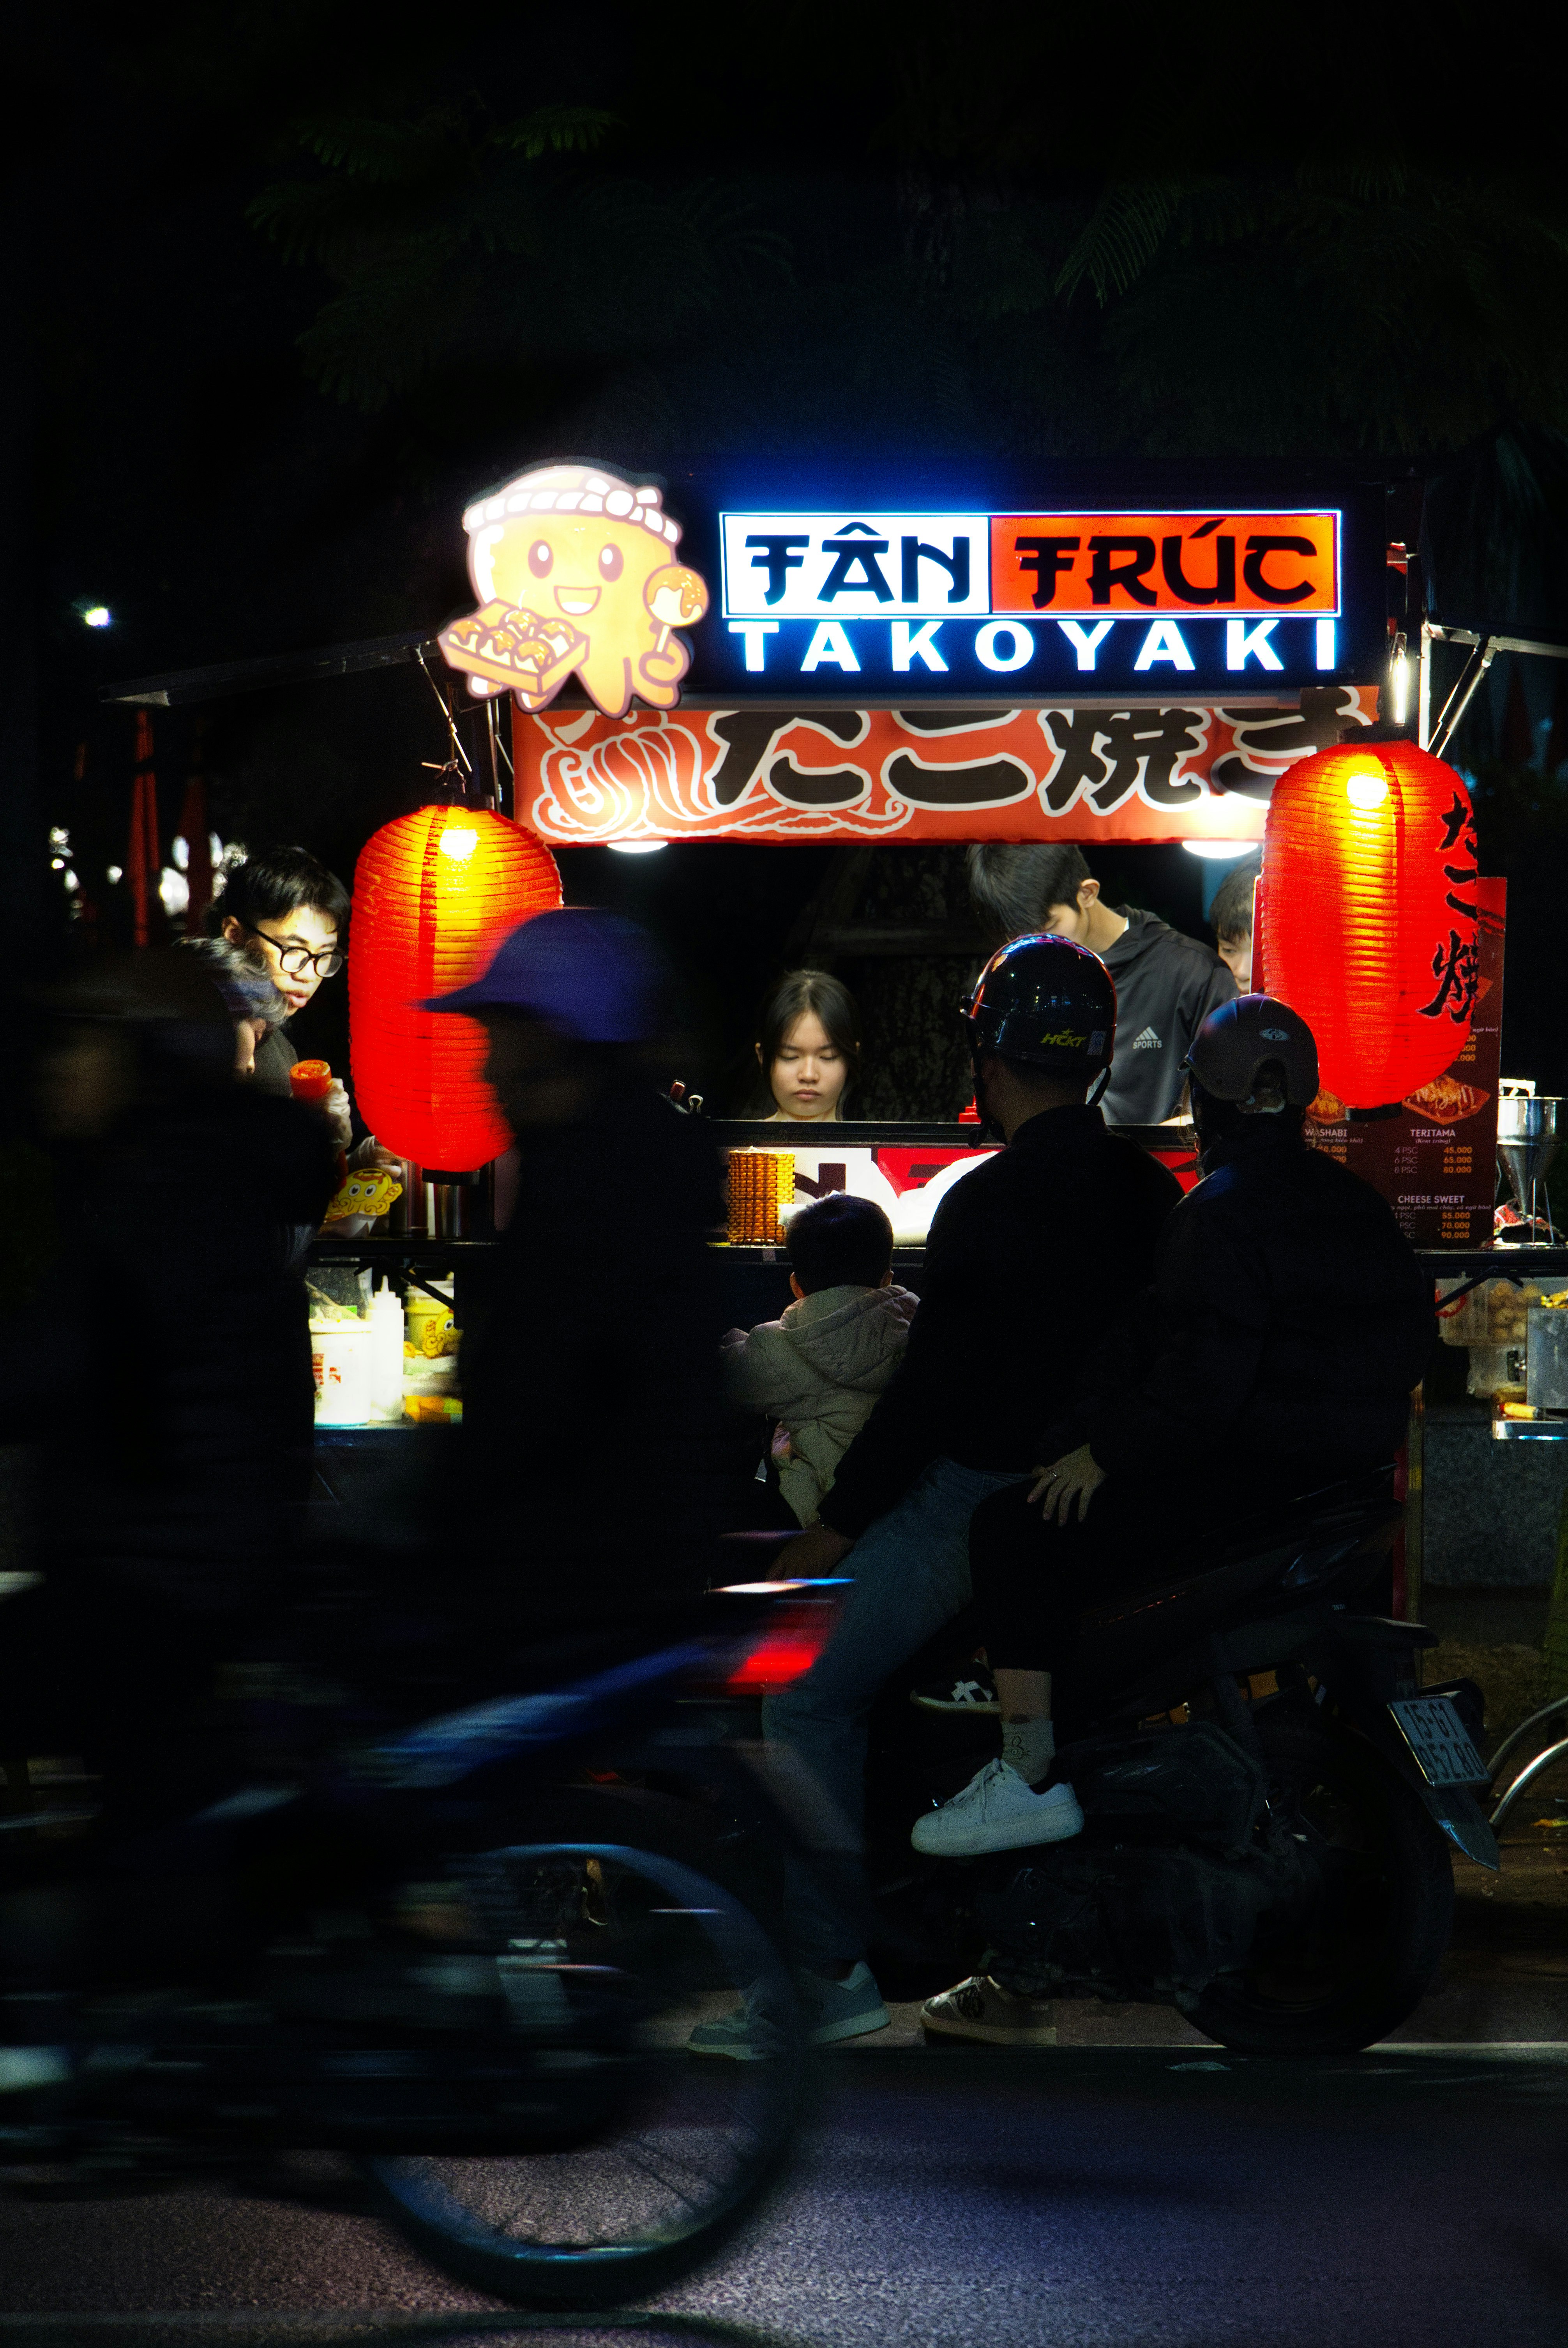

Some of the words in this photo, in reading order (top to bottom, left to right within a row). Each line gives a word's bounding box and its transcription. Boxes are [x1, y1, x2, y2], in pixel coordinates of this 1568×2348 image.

[745, 521, 971, 605] TÂN
[1015, 518, 1318, 609] TRÚC
[727, 619, 1336, 671] TAKOYAKI
[1133, 1040, 1162, 1049] SPORTS
[1410, 1129, 1456, 1137] TERITAMA
[1405, 1703, 1459, 1740] 15-G1
[1418, 1743, 1484, 1780] 952.80
